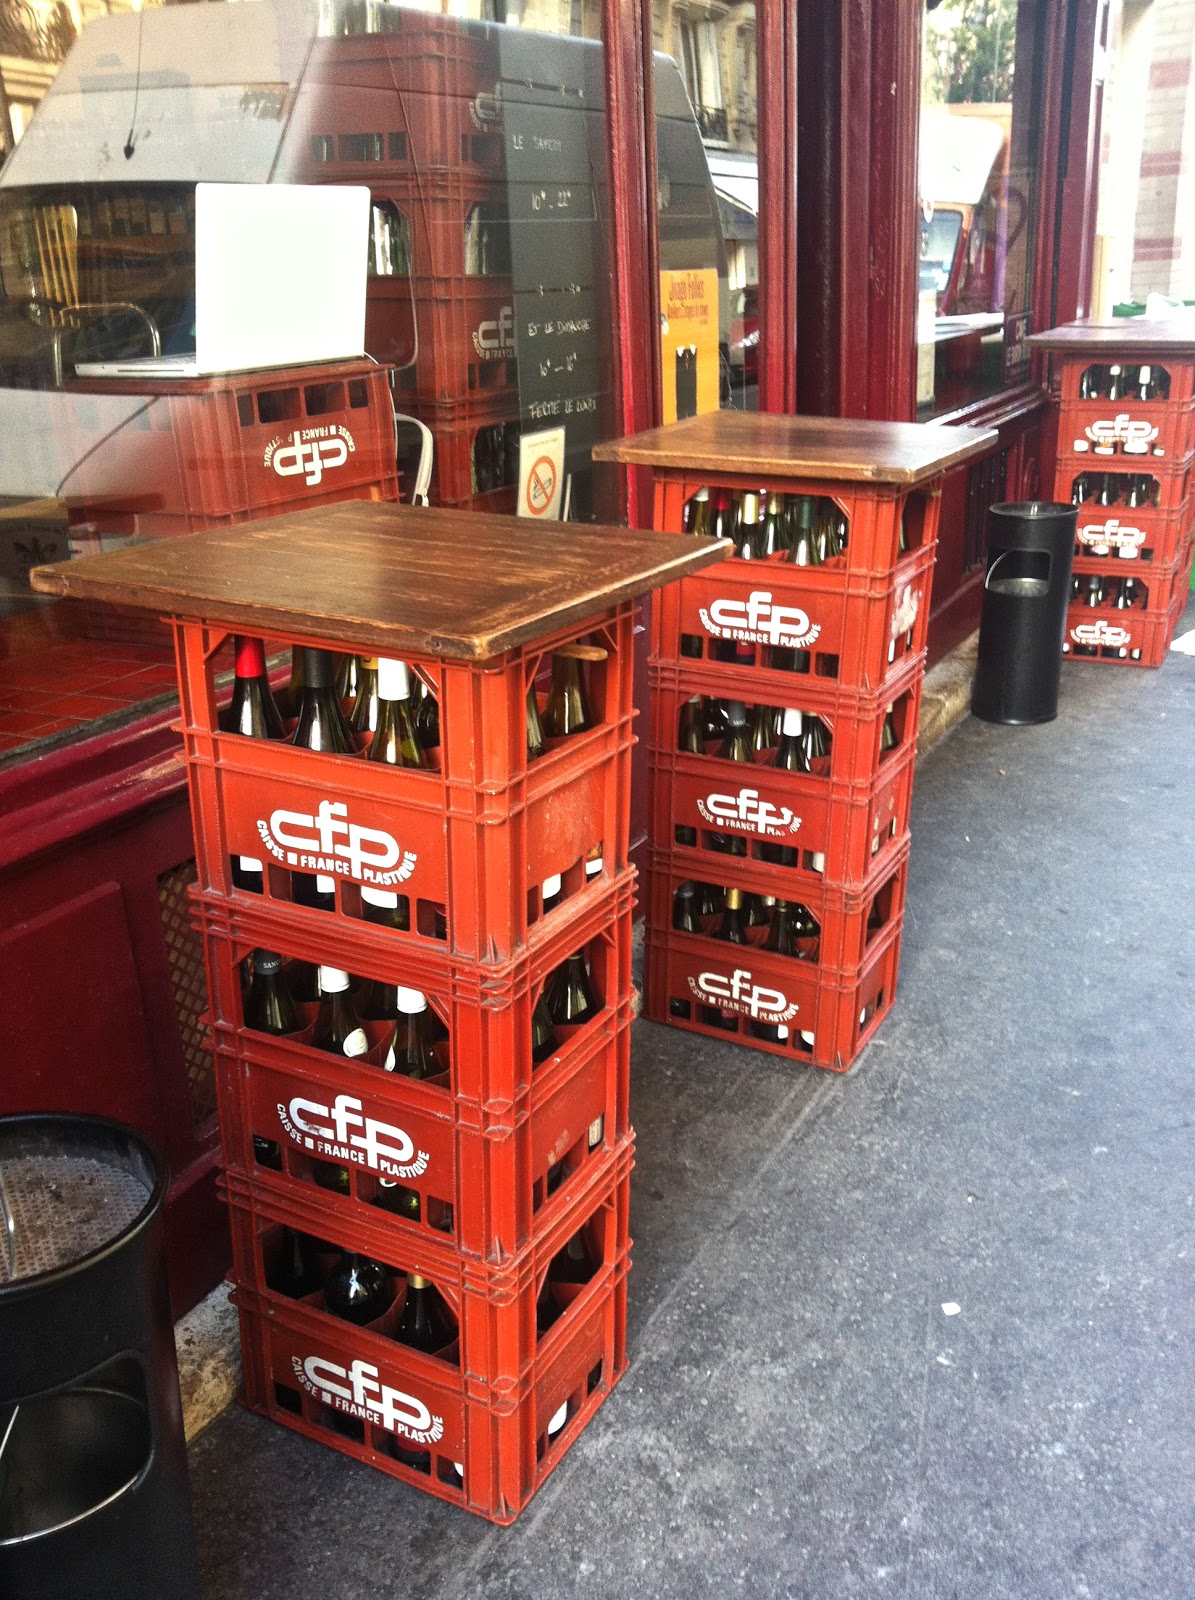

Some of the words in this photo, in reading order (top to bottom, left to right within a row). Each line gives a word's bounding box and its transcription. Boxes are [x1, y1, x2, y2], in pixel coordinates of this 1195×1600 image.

[512, 134, 524, 150] LE
[544, 322, 555, 335] LE
[302, 426, 329, 440] FRANCE
[337, 425, 356, 453] CAISSE
[698, 608, 722, 637] CAISSE
[732, 629, 769, 644] FRANCE
[779, 623, 822, 649] PLASTIQUE
[709, 590, 810, 646] cfp
[706, 788, 794, 834] cfp
[725, 818, 756, 833] FRANCE
[256, 819, 286, 862] CAISSE
[300, 855, 350, 876] FRANCE
[363, 850, 418, 886] PLASTIQUE
[269, 799, 400, 880] cfp
[698, 968, 787, 1018] cfp
[717, 997, 750, 1016] FRANCE
[759, 1002, 800, 1023] PLASTIQUE
[276, 1103, 303, 1145] CAISSE
[317, 1140, 366, 1165] FRANCE
[379, 1150, 431, 1179] PLASTIQUE
[288, 1094, 415, 1170] cfp
[291, 1355, 319, 1398] CAISSE
[335, 1396, 381, 1425] FRANCE
[397, 1414, 445, 1445] PLASTIQUE
[303, 1355, 432, 1431] cfp
